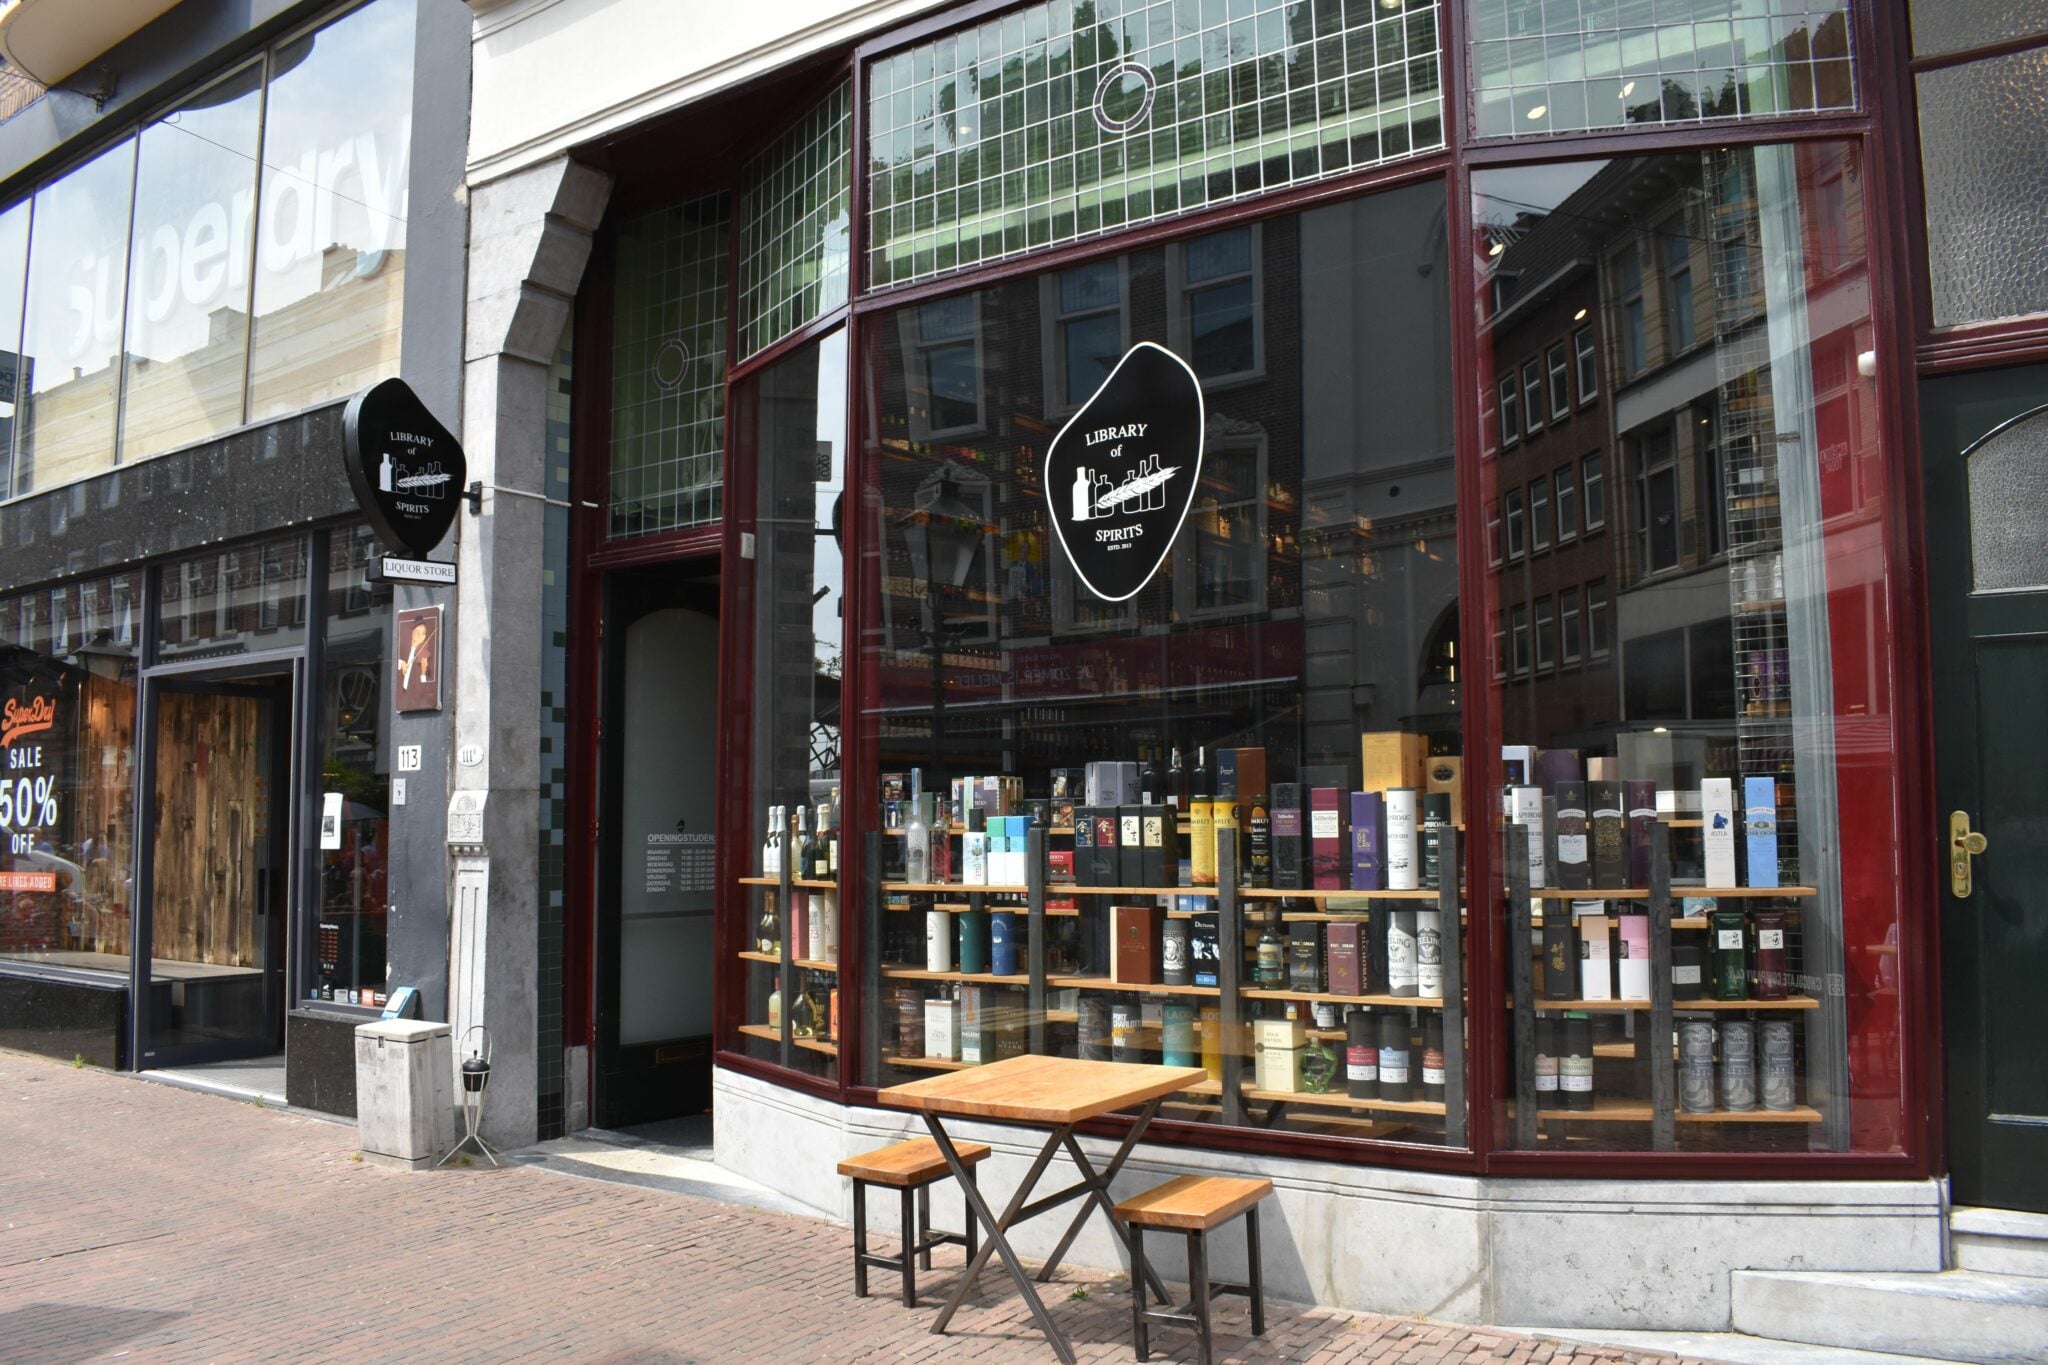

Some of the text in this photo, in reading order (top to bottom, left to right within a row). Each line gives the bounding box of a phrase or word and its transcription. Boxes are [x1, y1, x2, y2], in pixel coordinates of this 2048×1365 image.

[390, 431, 434, 447] LIBRARY
[1085, 423, 1148, 447] LIBRARY
[407, 447, 417, 456] of
[1110, 444, 1123, 457] of
[396, 500, 430, 515] SPIRITS
[1095, 523, 1144, 542] SPIRITS
[384, 561, 454, 578] LIQUOR STORE
[10, 746, 42, 769] SALE
[401, 749, 418, 768] 113
[0, 775, 57, 827] 50%
[11, 833, 35, 854] OFF
[8, 876, 28, 888] LINES
[29, 876, 52, 889] ADDED
